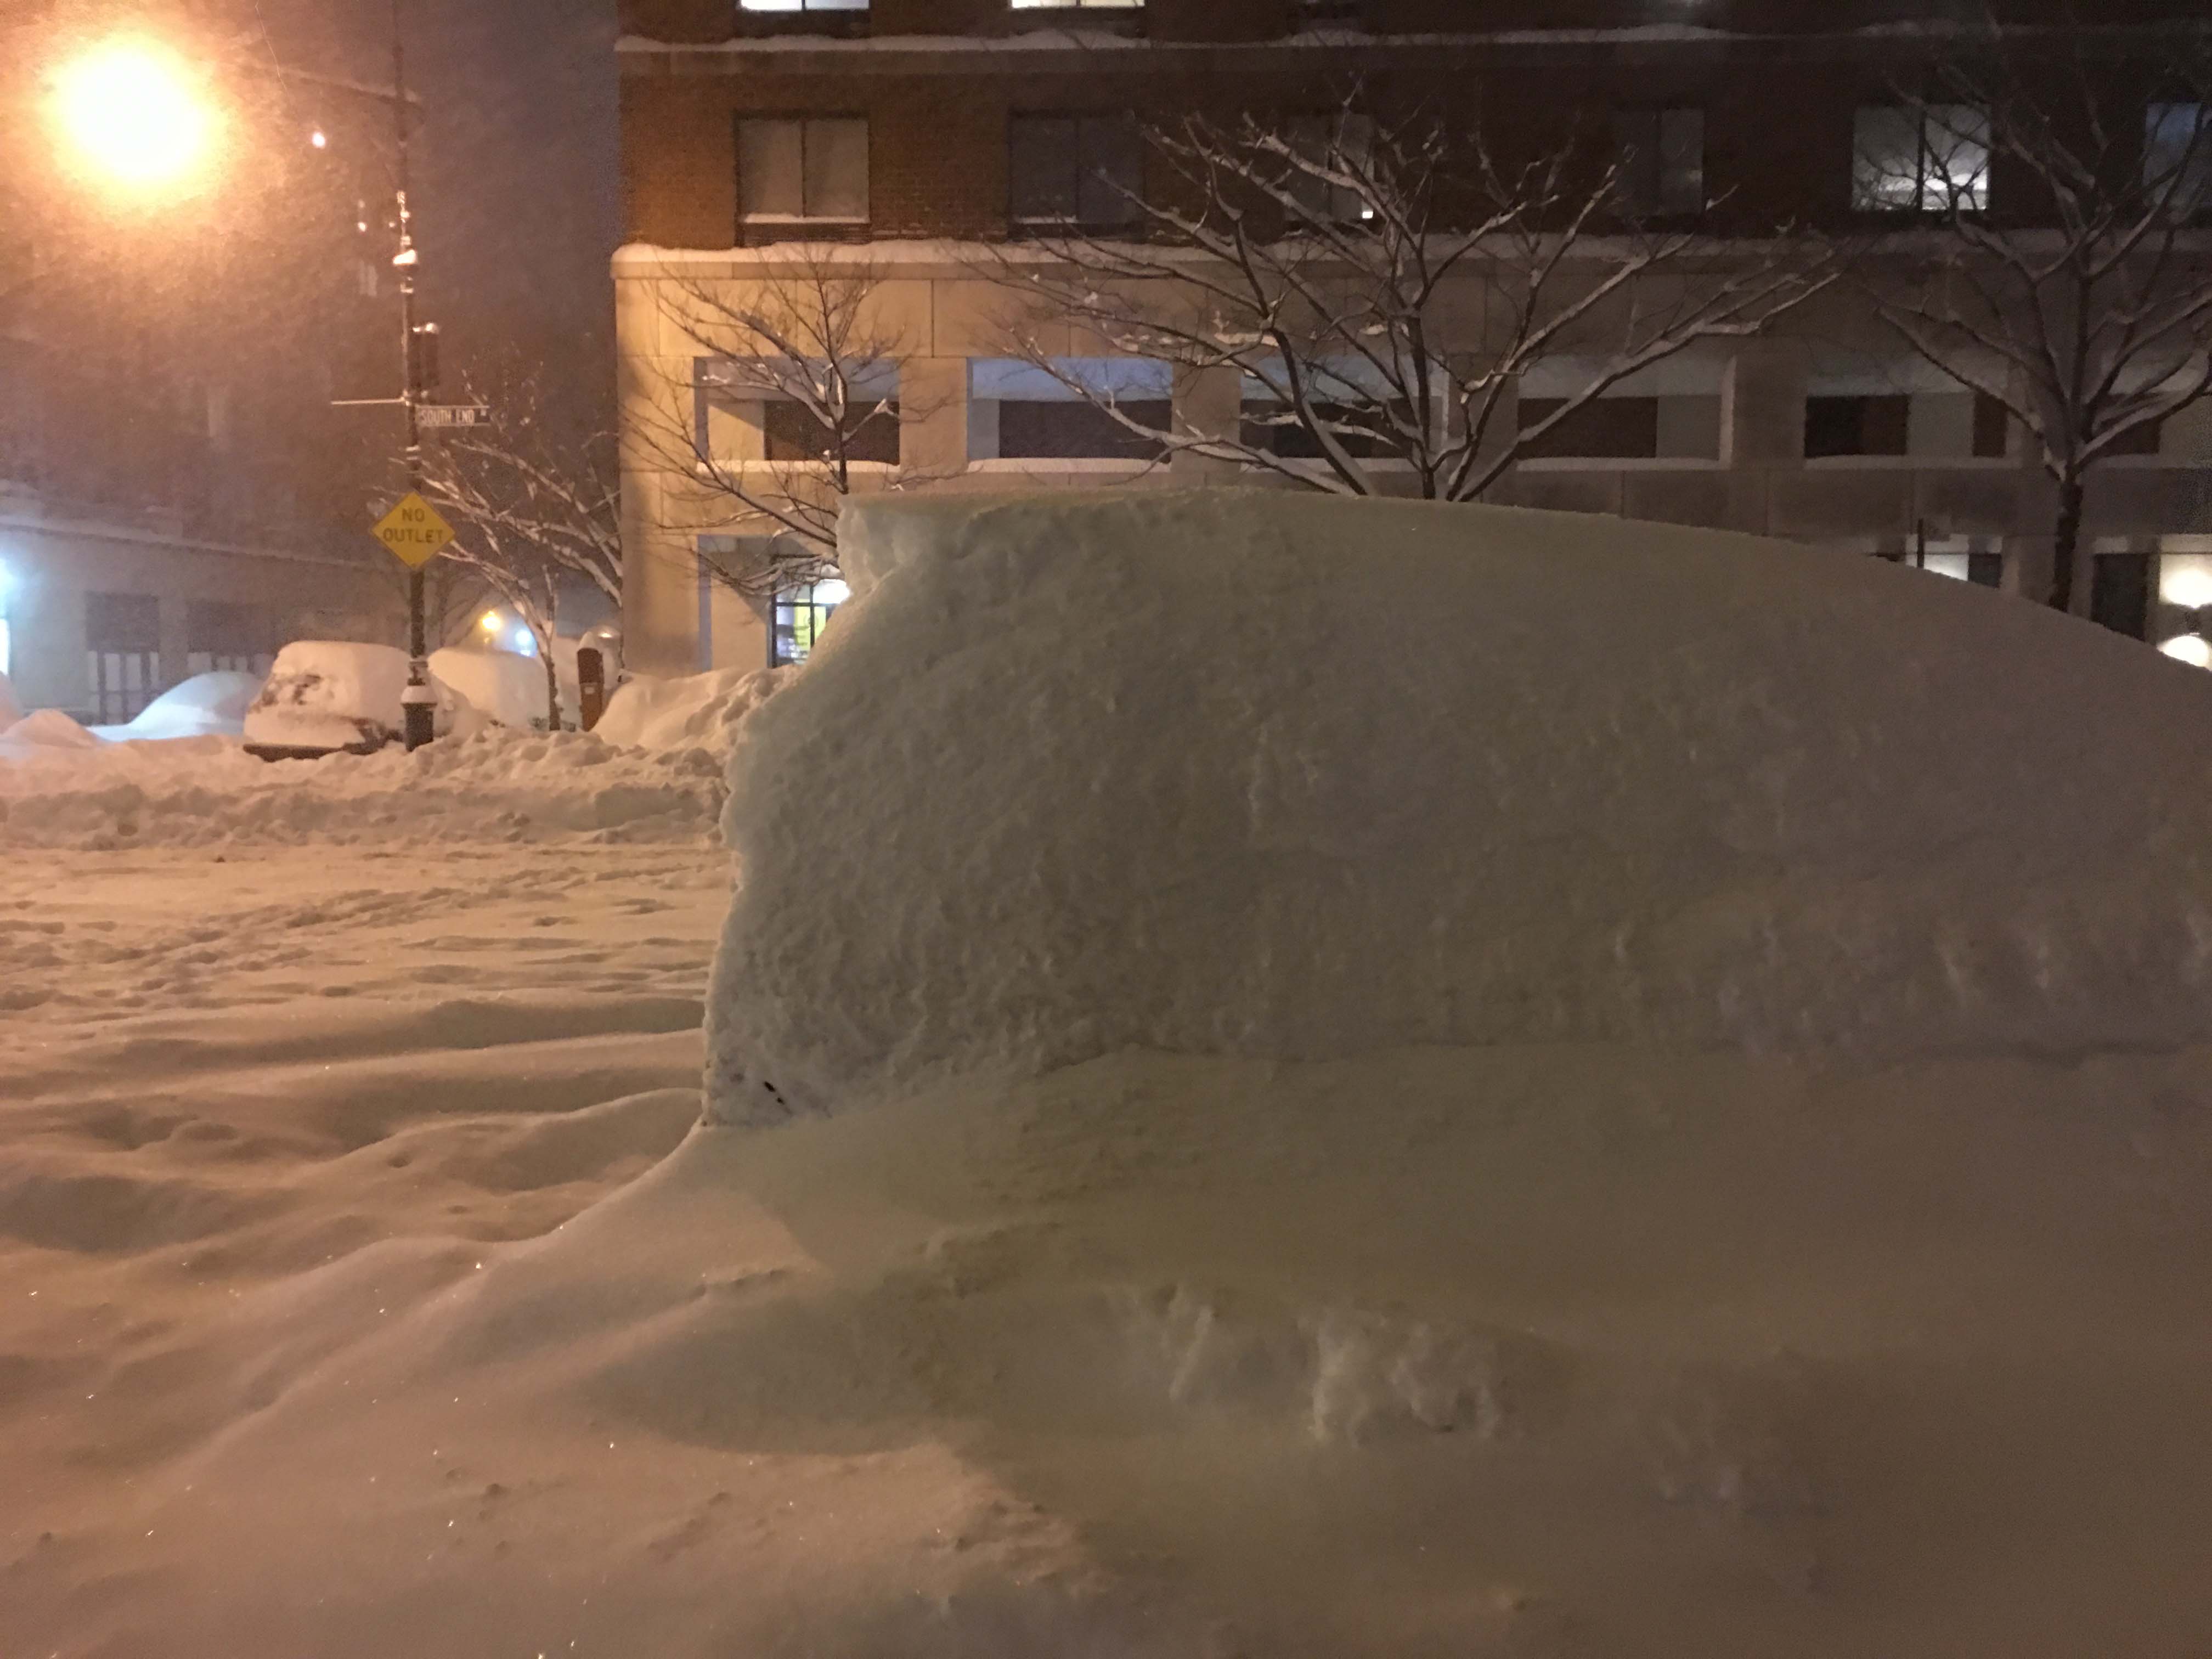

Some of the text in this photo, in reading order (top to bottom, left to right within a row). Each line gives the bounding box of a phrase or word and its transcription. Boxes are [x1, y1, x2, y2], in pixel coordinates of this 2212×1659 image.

[420, 409, 451, 424] SOUTH
[456, 409, 475, 424] END
[402, 508, 425, 522] NO
[383, 528, 443, 543] OUTLET
